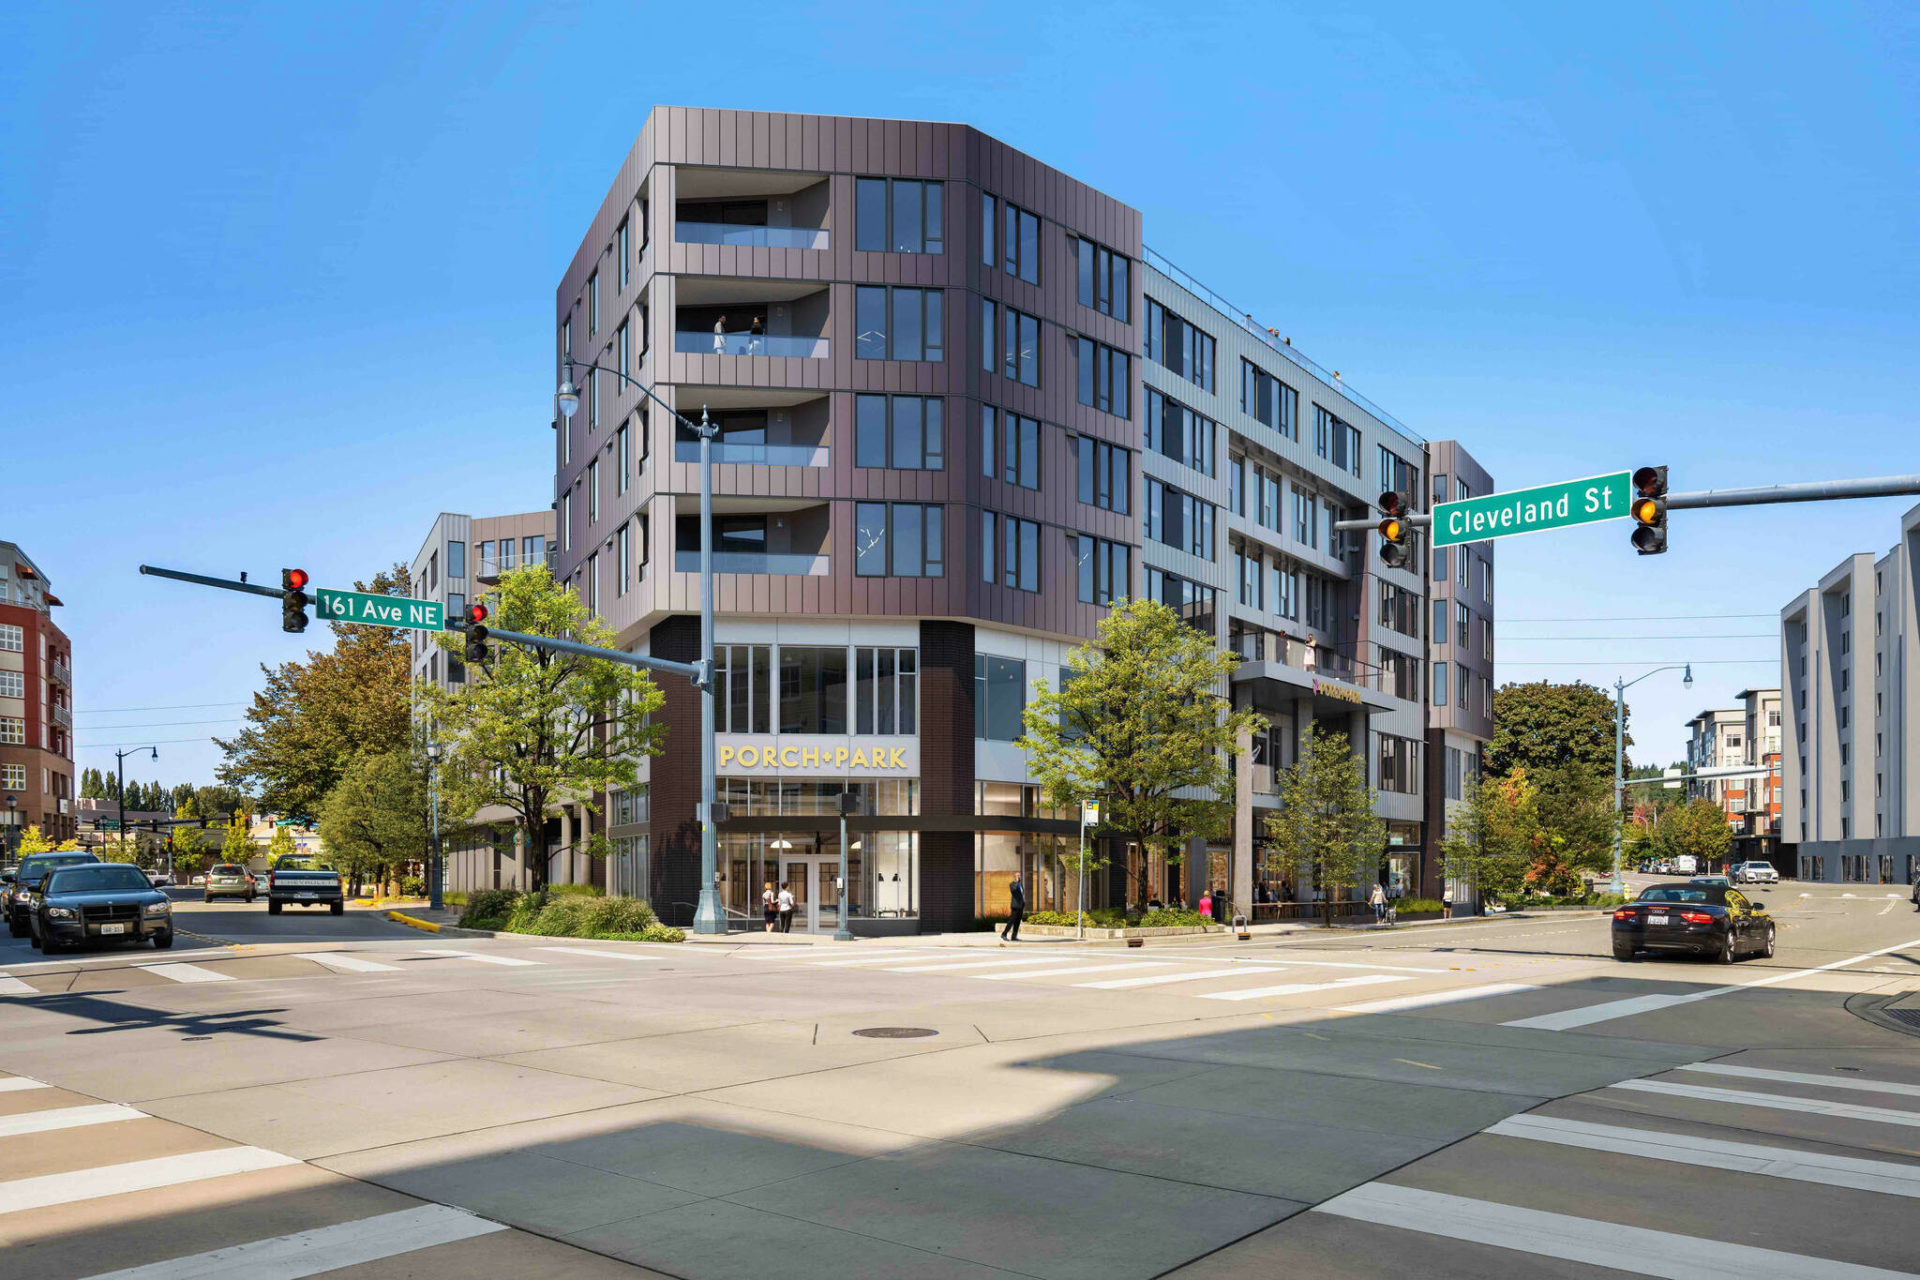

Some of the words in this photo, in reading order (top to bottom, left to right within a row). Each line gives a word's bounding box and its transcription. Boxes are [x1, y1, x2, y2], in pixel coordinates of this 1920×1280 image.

[1449, 493, 1569, 535] Cleveland
[1584, 485, 1612, 513] St
[323, 594, 354, 616] 161
[362, 600, 402, 621] Ave
[410, 604, 437, 625] NE
